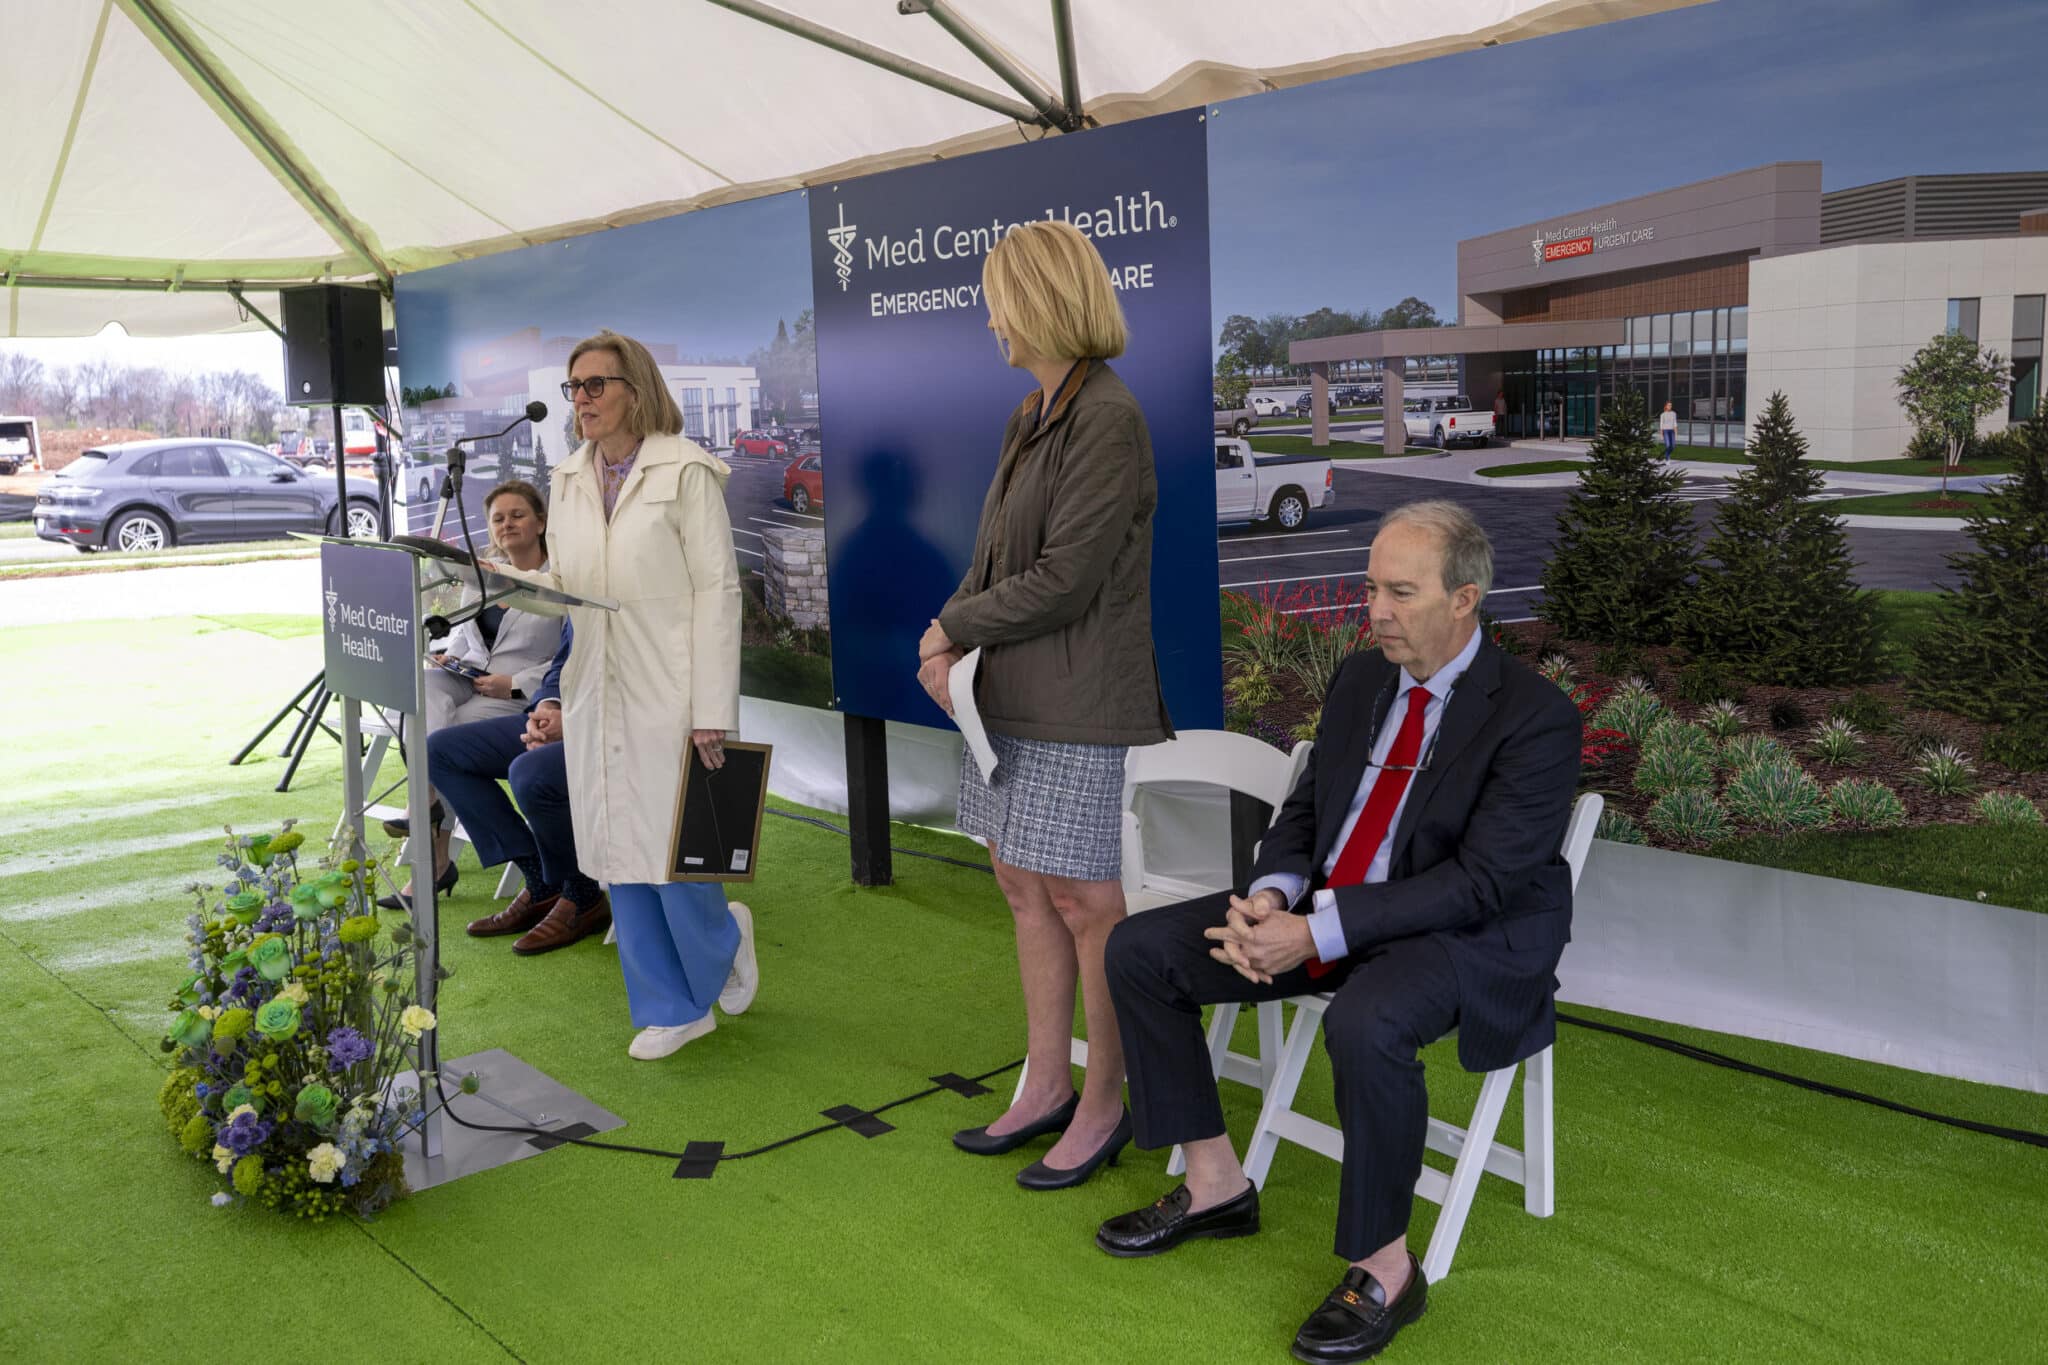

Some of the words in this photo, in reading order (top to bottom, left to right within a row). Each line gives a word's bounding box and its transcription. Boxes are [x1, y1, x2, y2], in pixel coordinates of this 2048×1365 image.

[865, 227, 926, 270] Med
[933, 218, 1038, 260] Cent
[1545, 231, 1562, 242] Med
[1563, 226, 1590, 240] Center
[1591, 217, 1618, 233] Health
[1545, 240, 1592, 259] EMERGENCY
[1598, 231, 1631, 249] URGENT
[1632, 227, 1654, 242] CARE
[870, 284, 981, 317] EMERGENCY
[1110, 263, 1153, 290] ARE
[340, 603, 366, 627] Med
[367, 608, 408, 636] Center
